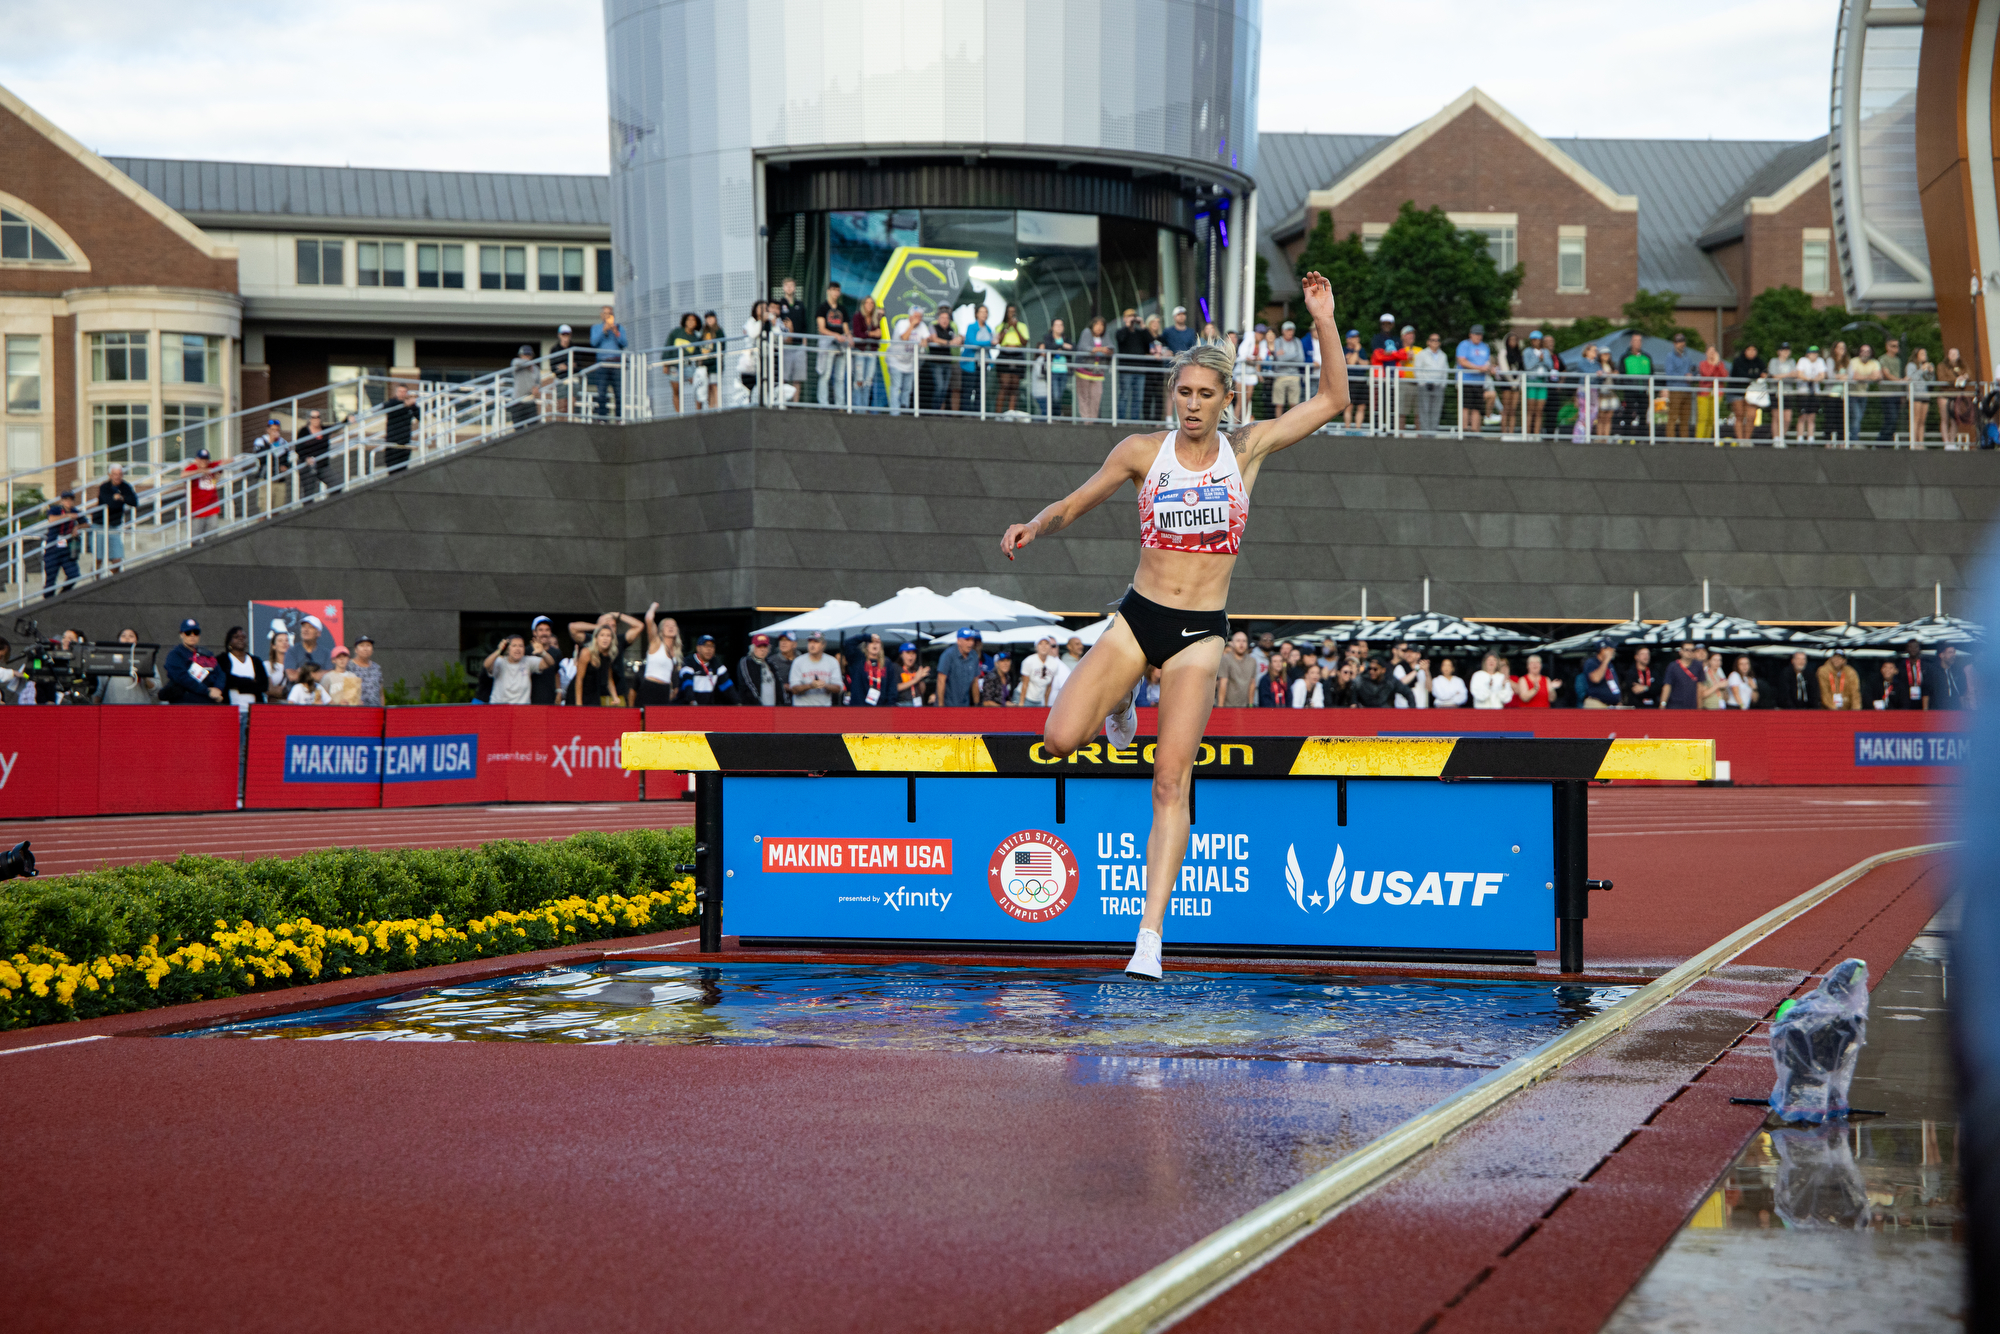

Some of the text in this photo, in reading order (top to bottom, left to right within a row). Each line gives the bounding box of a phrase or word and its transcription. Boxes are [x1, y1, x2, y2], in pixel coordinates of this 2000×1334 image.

[1159, 507, 1225, 528] MITCHELL
[291, 735, 632, 778] MAKING TEAM USA presented by xfinit
[1859, 737, 1971, 760] MAKING TEAM
[768, 844, 946, 868] MAKING TEAM USA
[998, 832, 1069, 856] UNITED STATES
[1098, 832, 1141, 859] U.S.
[1097, 864, 1249, 893] TEA RIALS
[838, 886, 953, 912] presented by xfinity
[999, 897, 1068, 920] OLYMPIC TEAM
[1171, 897, 1212, 916] FIELD
